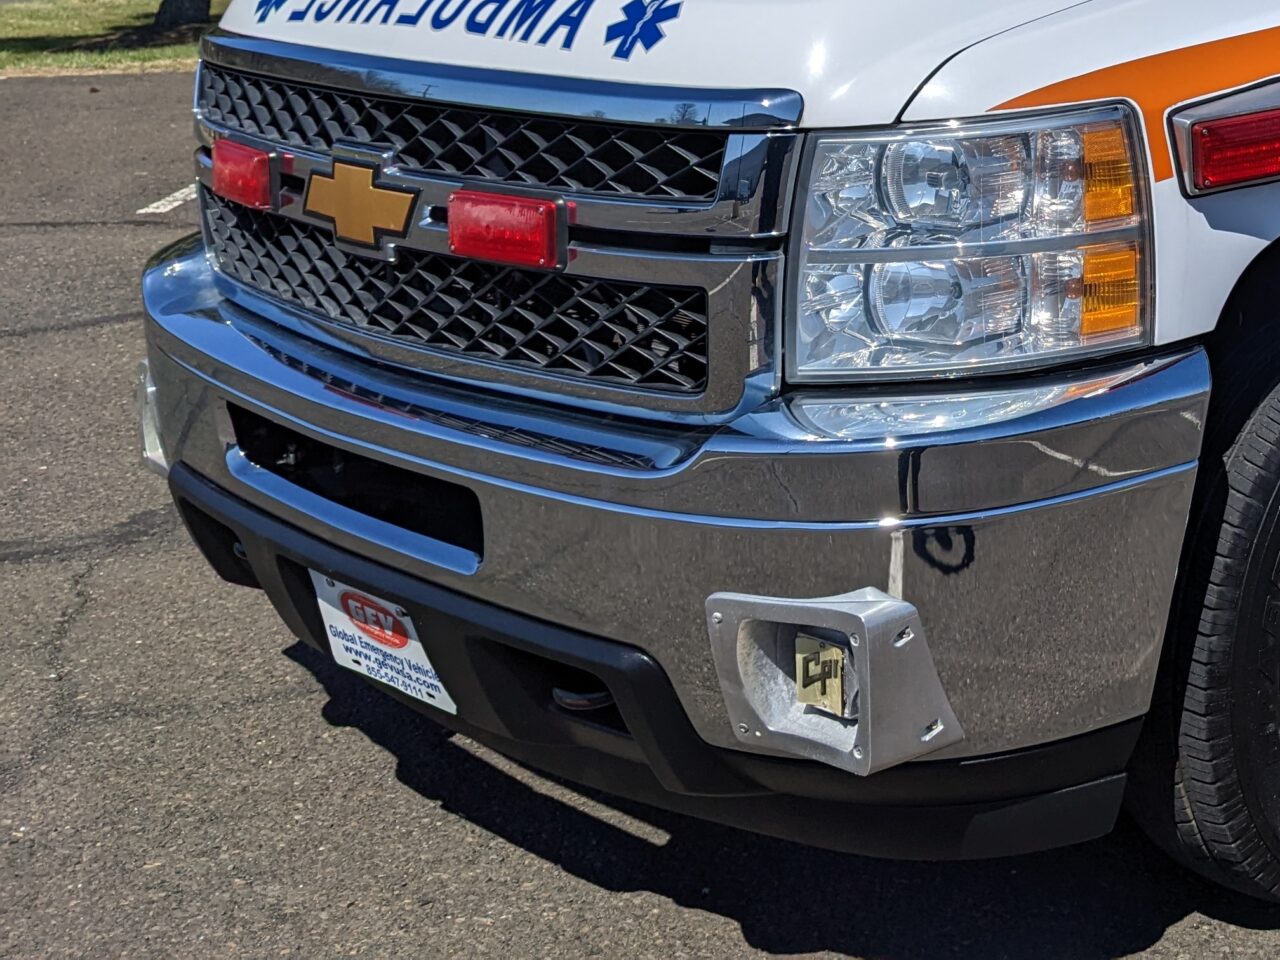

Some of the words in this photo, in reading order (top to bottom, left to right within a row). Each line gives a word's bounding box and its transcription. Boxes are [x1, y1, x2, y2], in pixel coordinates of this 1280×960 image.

[348, 598, 394, 636] GEV
[329, 624, 358, 645] Global
[359, 635, 405, 670] Emergency
[343, 643, 442, 694] www.gevusa.com
